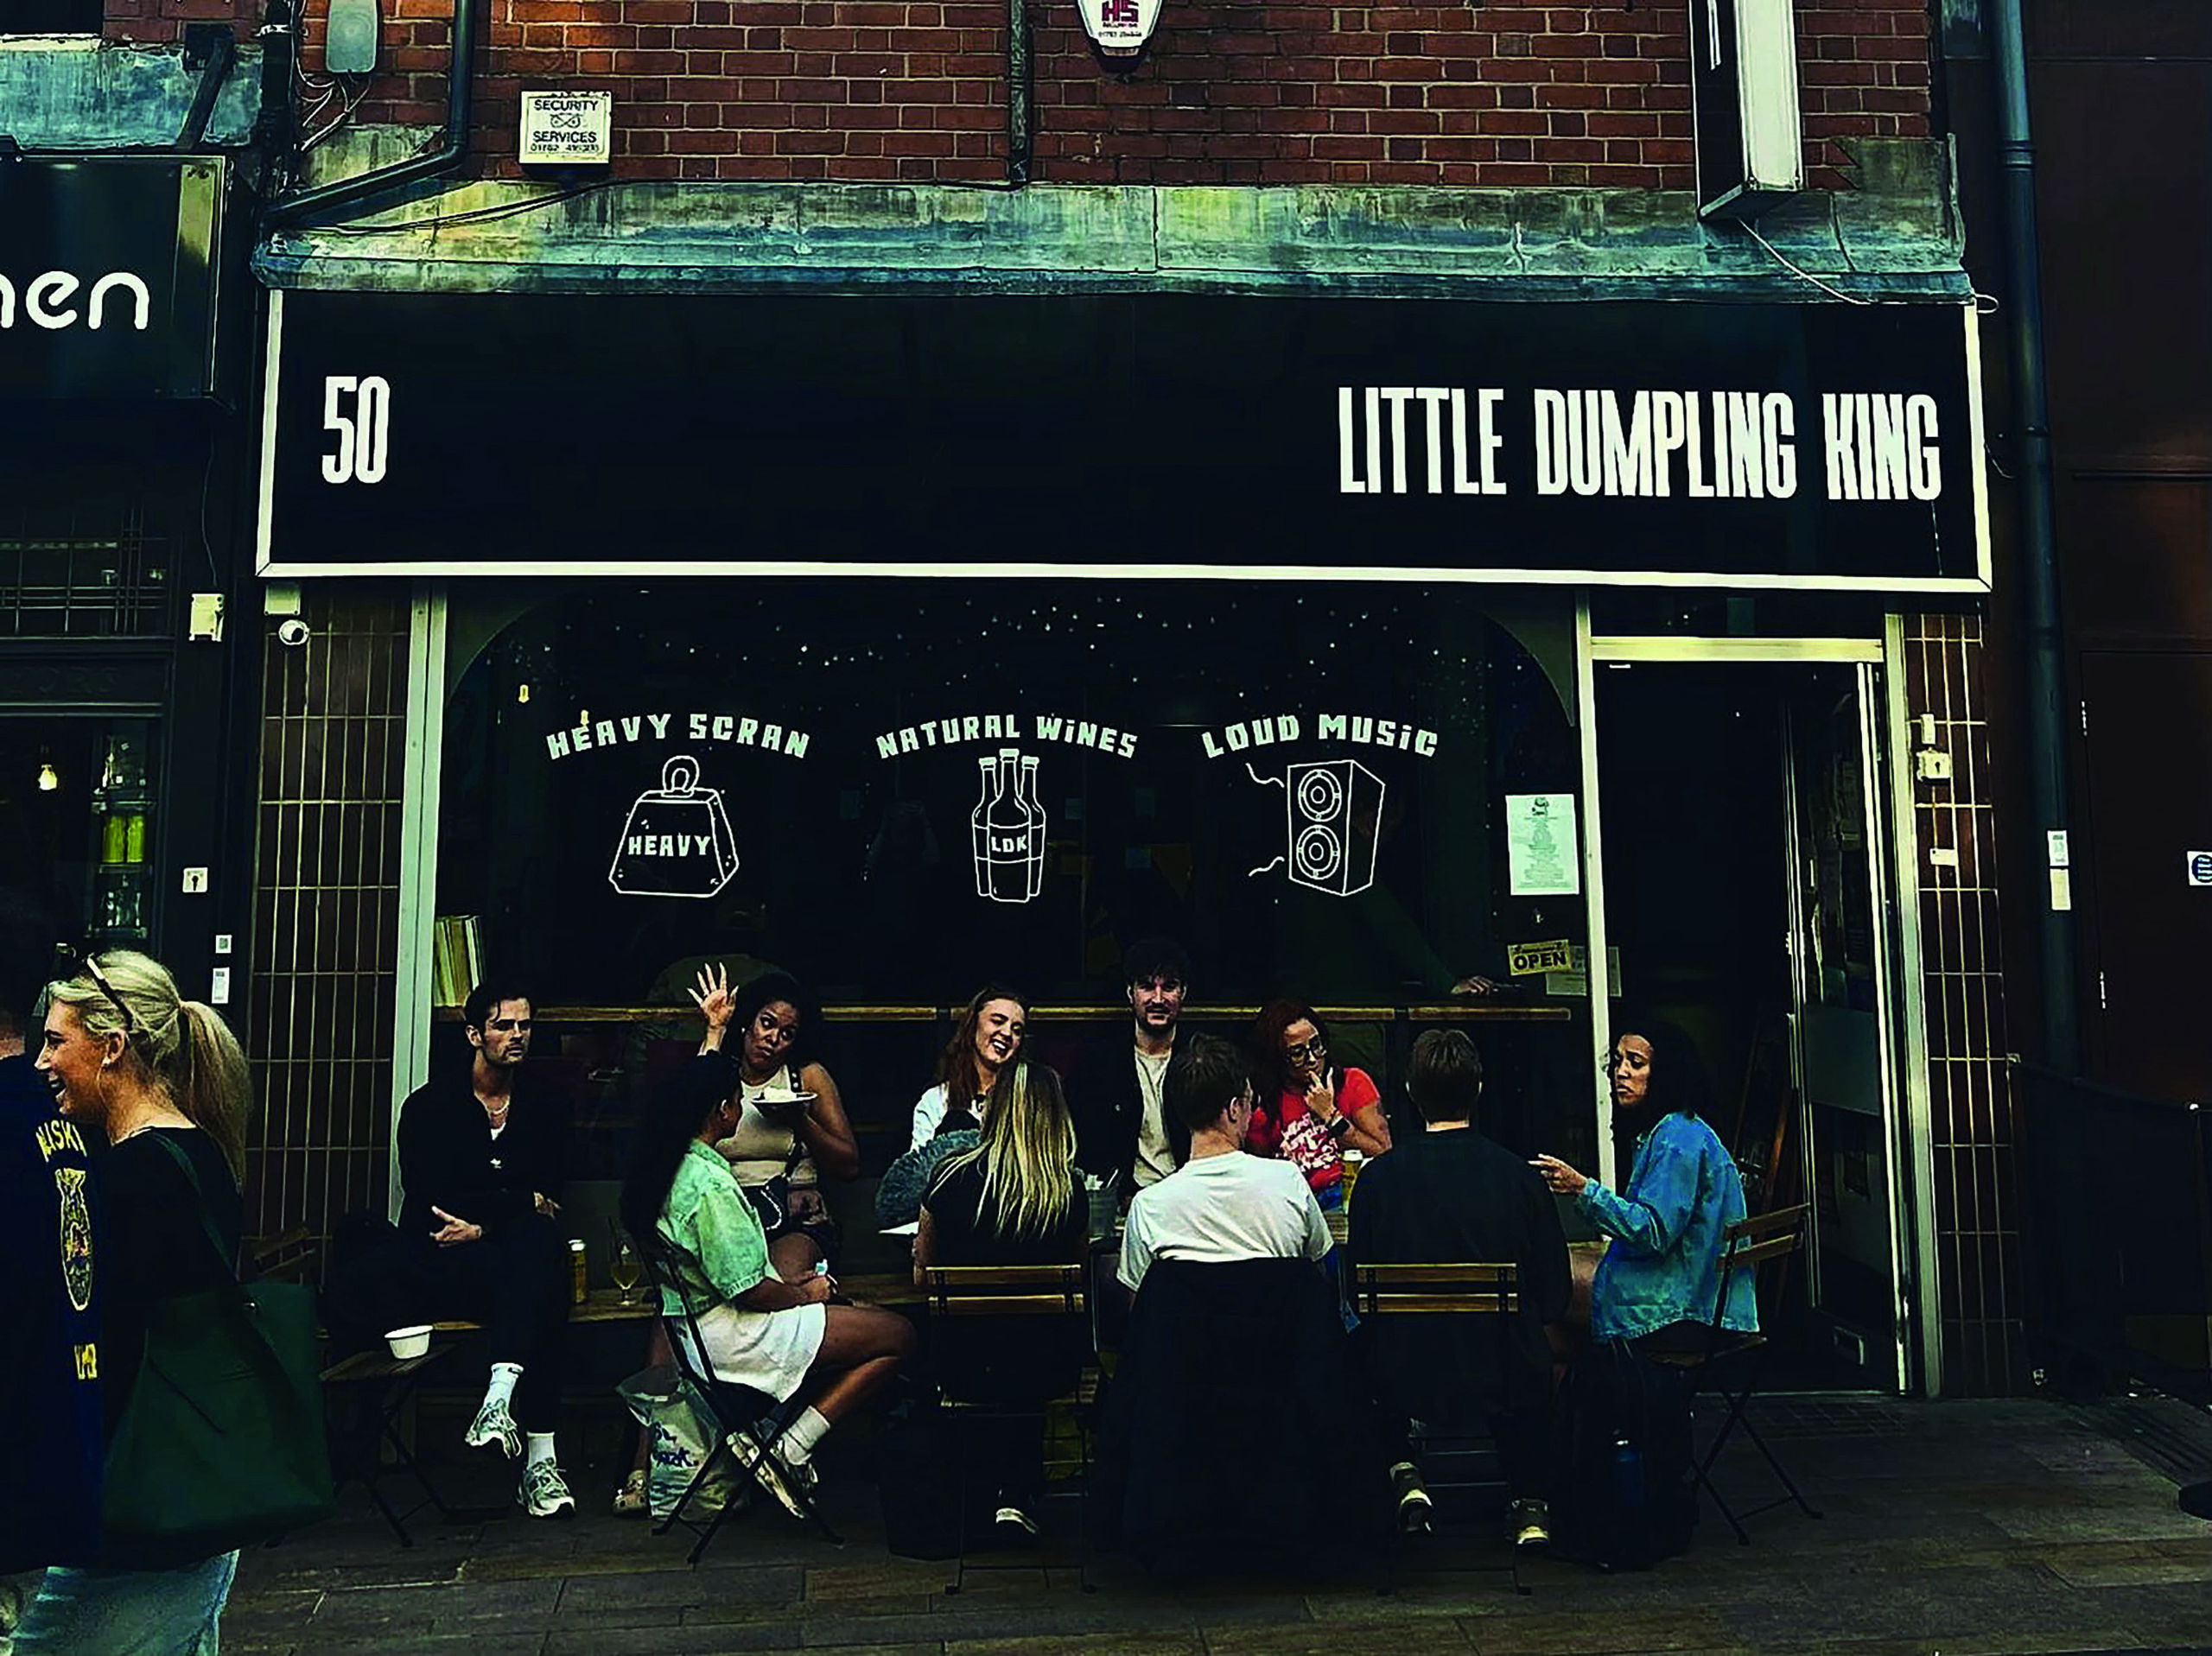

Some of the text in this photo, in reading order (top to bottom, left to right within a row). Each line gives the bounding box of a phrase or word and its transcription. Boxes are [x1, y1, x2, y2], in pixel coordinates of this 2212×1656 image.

[534, 99, 598, 111] SECURITY
[532, 131, 598, 143] SERVICES
[0, 271, 149, 329] en
[322, 377, 390, 483] 50
[1339, 387, 1941, 500] LITTLE DUMPLING KING
[546, 714, 810, 759] HEAVY SCRAN
[875, 714, 1020, 759] NATURAL
[1201, 714, 1300, 758] LOUD
[627, 835, 711, 857] HEAVY
[990, 834, 1027, 853] LDK
[1513, 951, 1567, 971] OPEN
